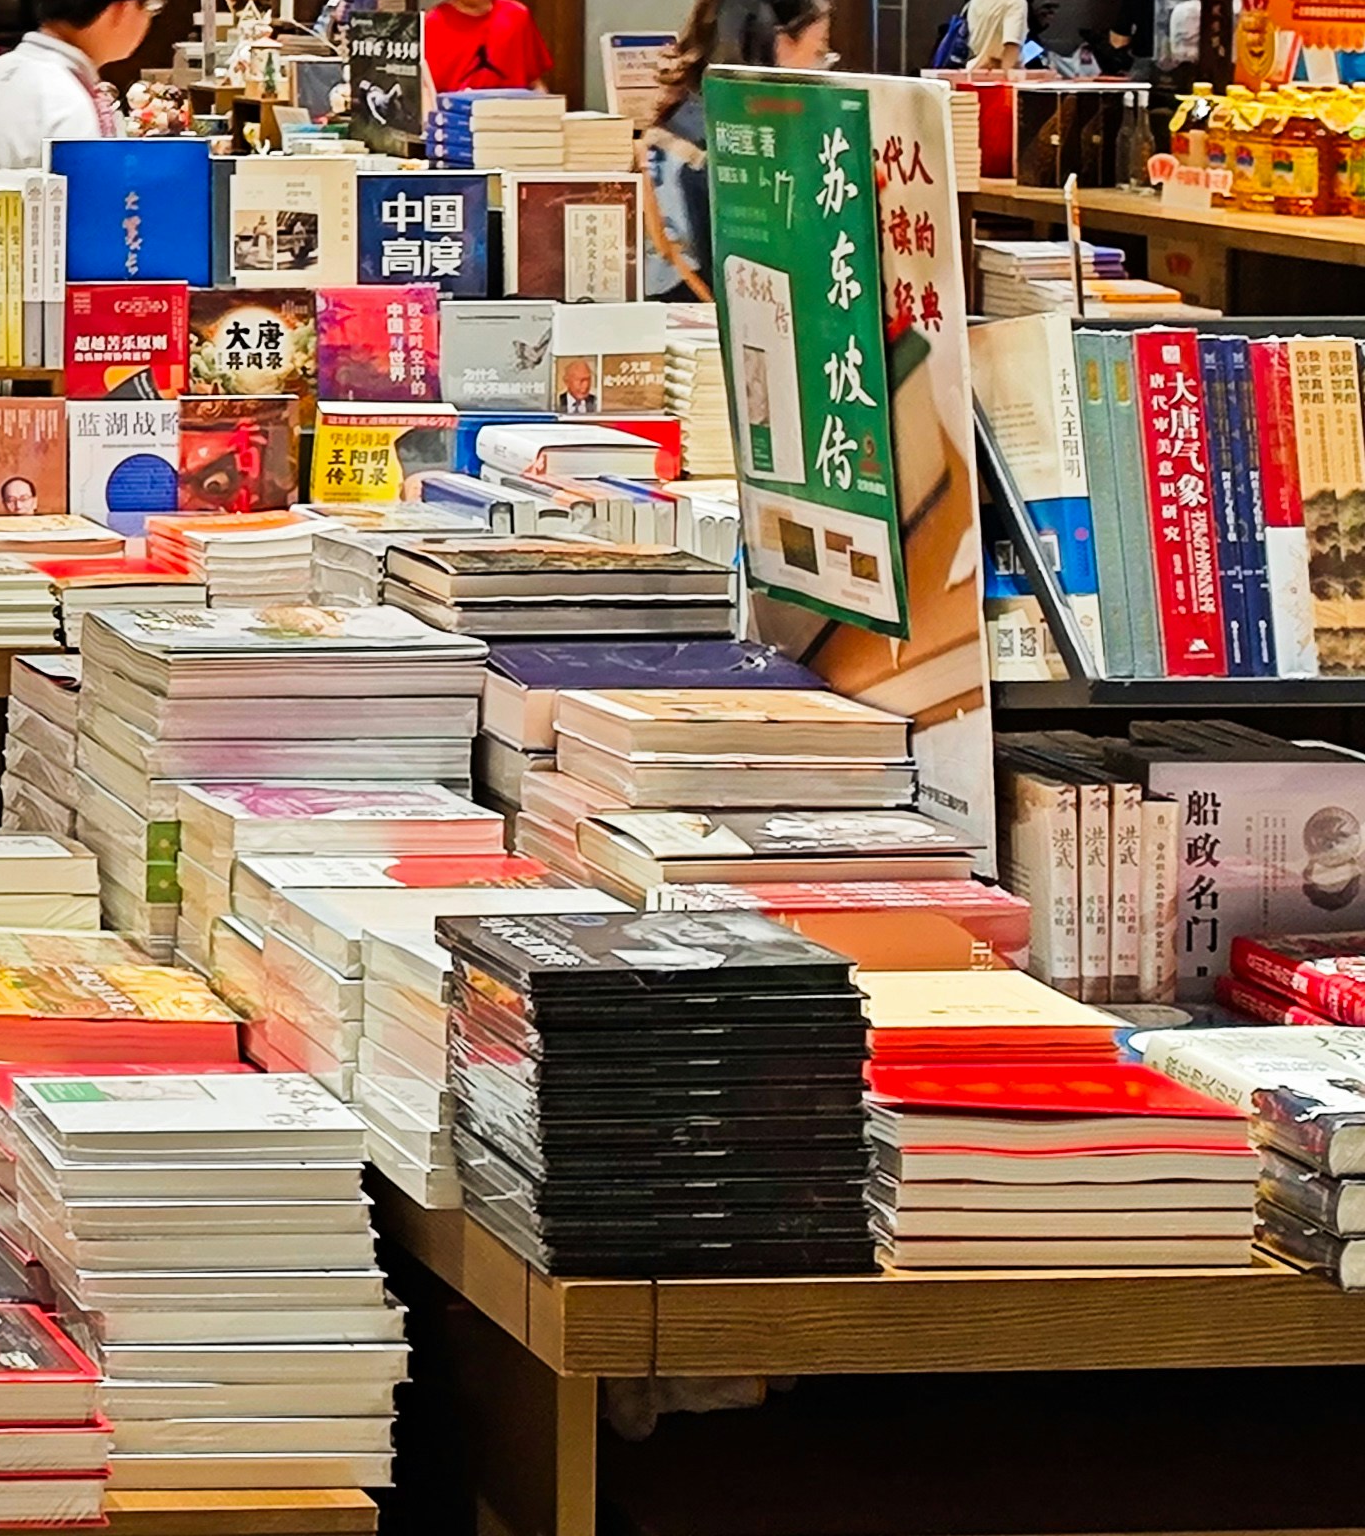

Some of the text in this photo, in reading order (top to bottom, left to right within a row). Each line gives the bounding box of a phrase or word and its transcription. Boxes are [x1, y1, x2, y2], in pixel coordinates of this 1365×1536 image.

[872, 135, 934, 186] 代人
[381, 191, 464, 233] 中国
[881, 205, 936, 258] 读的
[381, 235, 463, 277] 高度
[814, 126, 878, 491] 苏东坡传
[225, 319, 285, 351] 大唐
[225, 351, 285, 371] 异闻录
[1057, 367, 1082, 479] 千古一人王阳明
[1167, 371, 1209, 508] 大唐气象
[326, 467, 388, 486] 传习录
[327, 448, 389, 466] 王阳明
[1184, 789, 1222, 954] 船政名门
